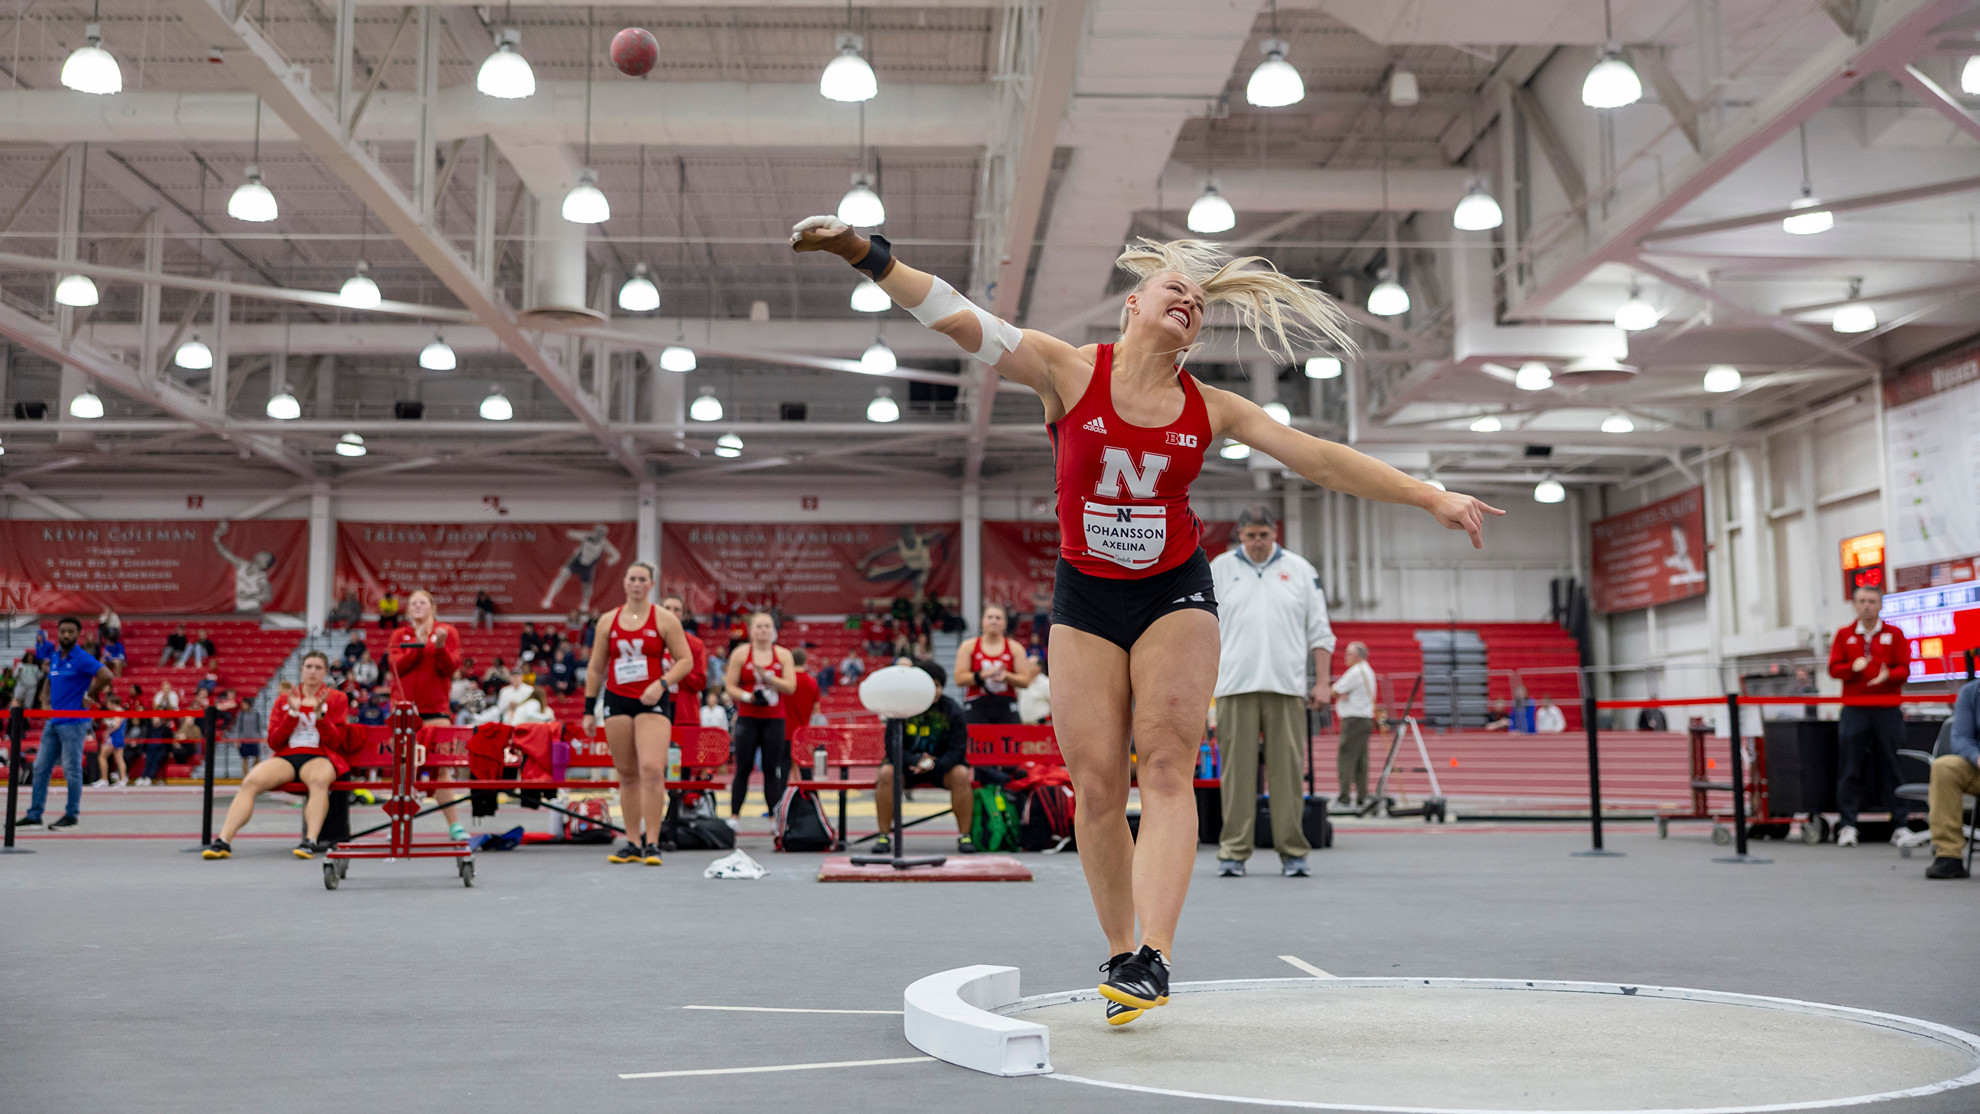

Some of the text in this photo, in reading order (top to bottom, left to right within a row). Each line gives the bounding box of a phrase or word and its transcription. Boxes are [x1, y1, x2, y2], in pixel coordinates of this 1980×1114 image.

[1083, 424, 1107, 435] adidas
[1094, 445, 1171, 500] N
[1117, 508, 1132, 522] N
[42, 527, 197, 542] KEVIN COLEMAN
[364, 529, 427, 543] TRESSA
[689, 530, 766, 544] RHONDA
[1086, 524, 1164, 539] JOHANSSON
[1102, 540, 1146, 551] AXELINA
[617, 638, 644, 659] N
